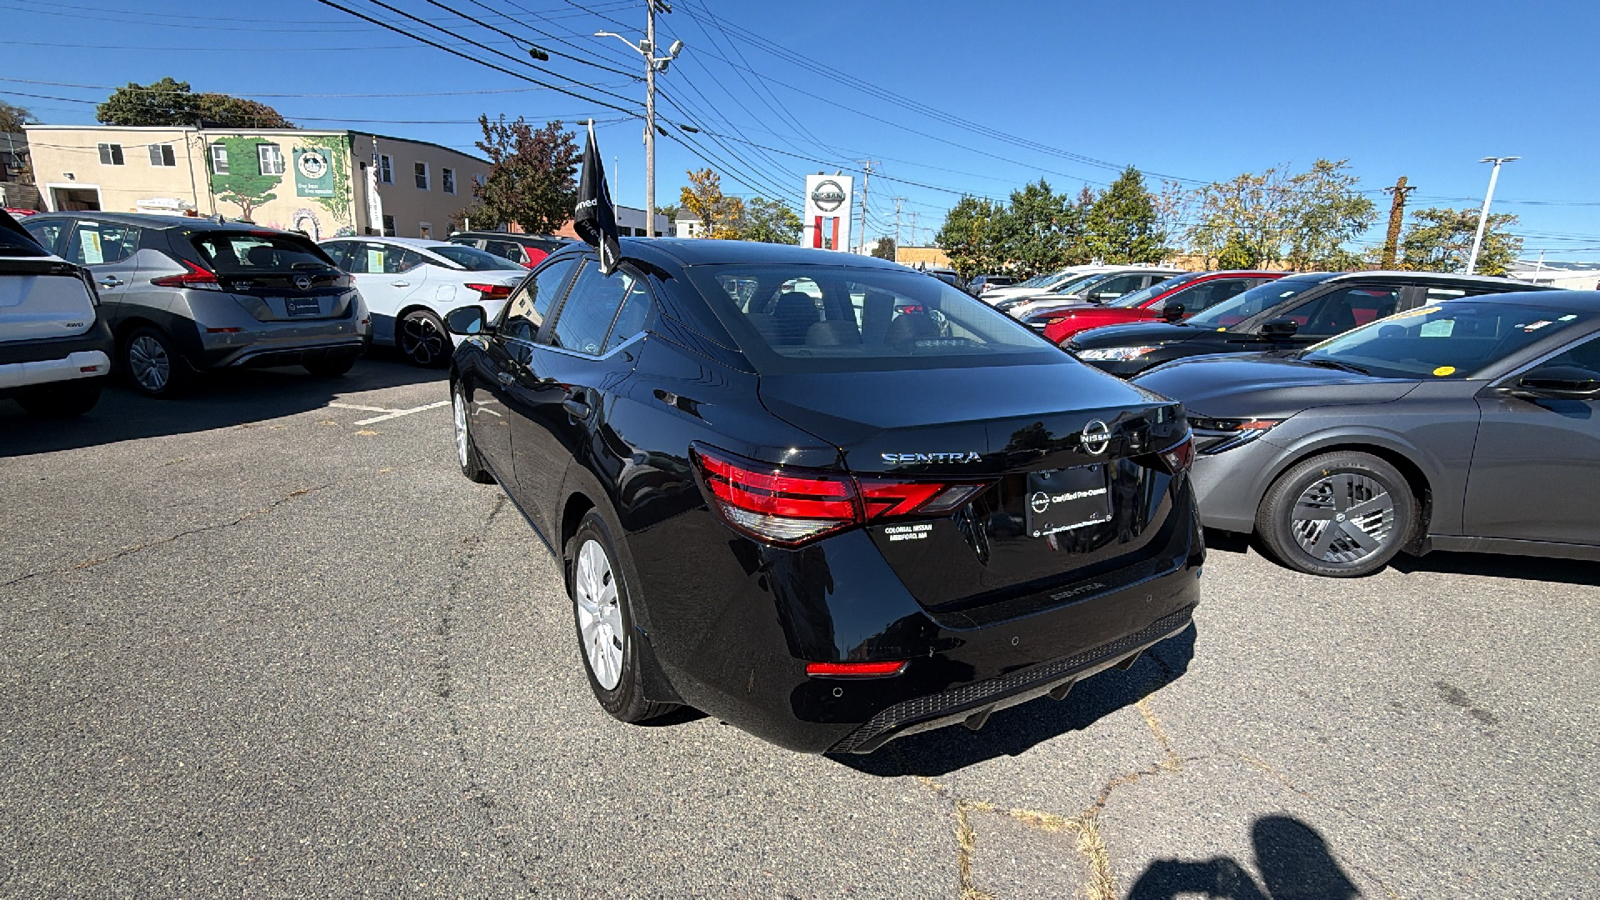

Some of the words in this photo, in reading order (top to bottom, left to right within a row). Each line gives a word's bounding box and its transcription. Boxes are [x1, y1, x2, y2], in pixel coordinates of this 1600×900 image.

[1080, 433, 1112, 443] NISSAN
[882, 451, 982, 465] SENTRA
[885, 526, 912, 534] COLONIAL
[913, 524, 933, 532] NISSAN
[1050, 582, 1106, 600] SENTRA
